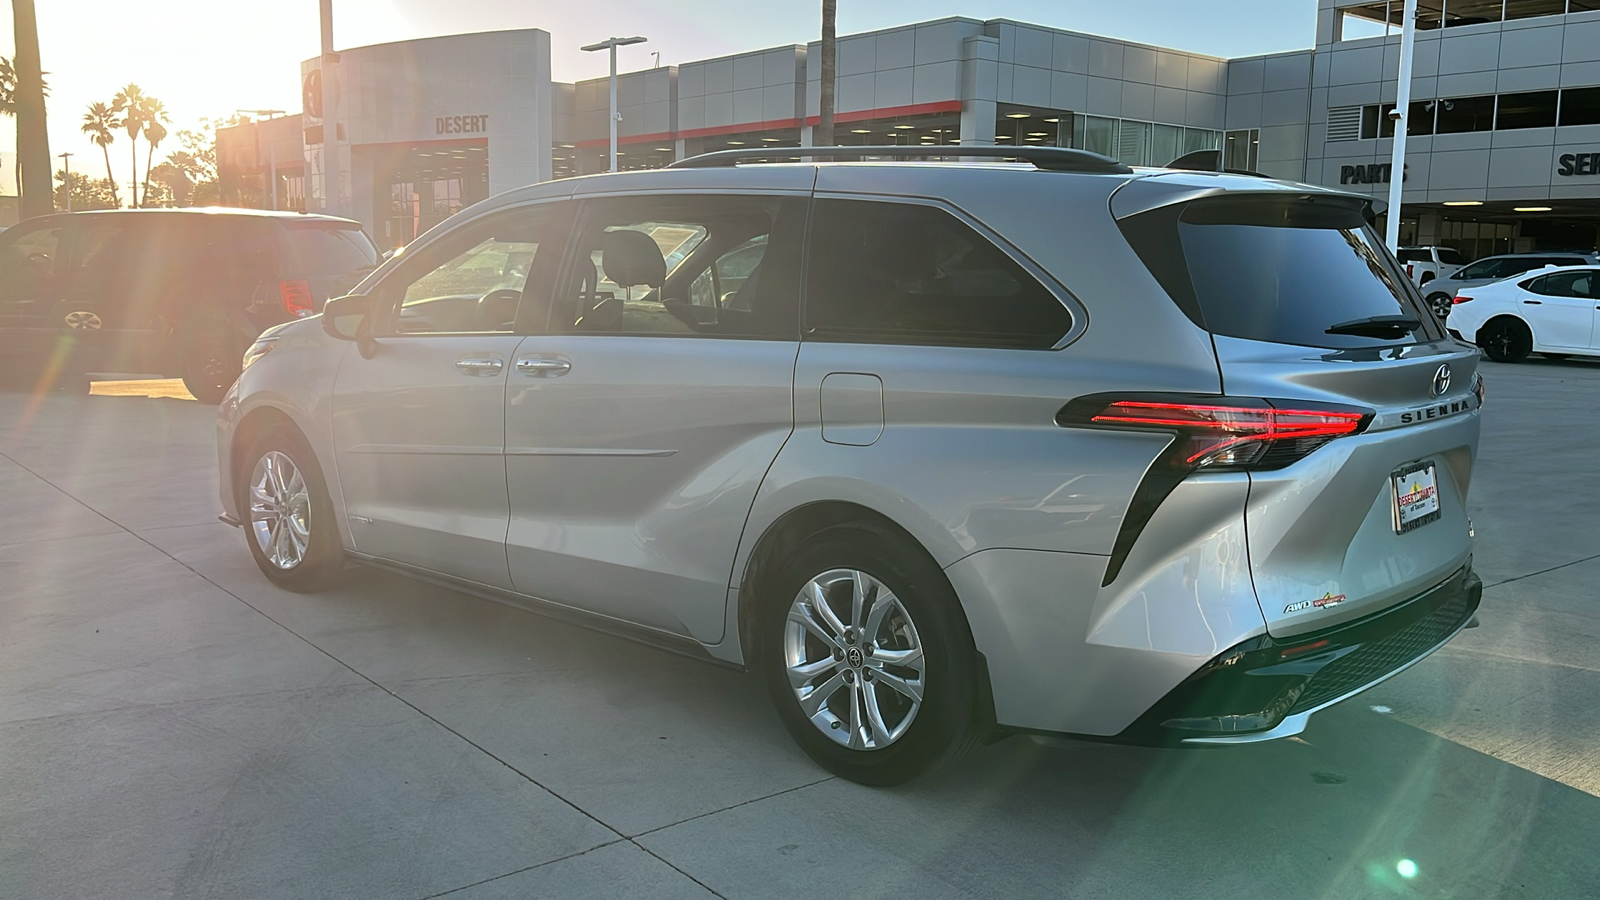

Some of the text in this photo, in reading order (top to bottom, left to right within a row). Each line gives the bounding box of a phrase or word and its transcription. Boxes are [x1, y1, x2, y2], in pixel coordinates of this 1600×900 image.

[436, 115, 489, 134] DESERT
[1340, 163, 1408, 184] PART
[1401, 401, 1469, 423] SIENNA
[1399, 492, 1417, 507] DESERT
[1283, 600, 1311, 613] AWD
